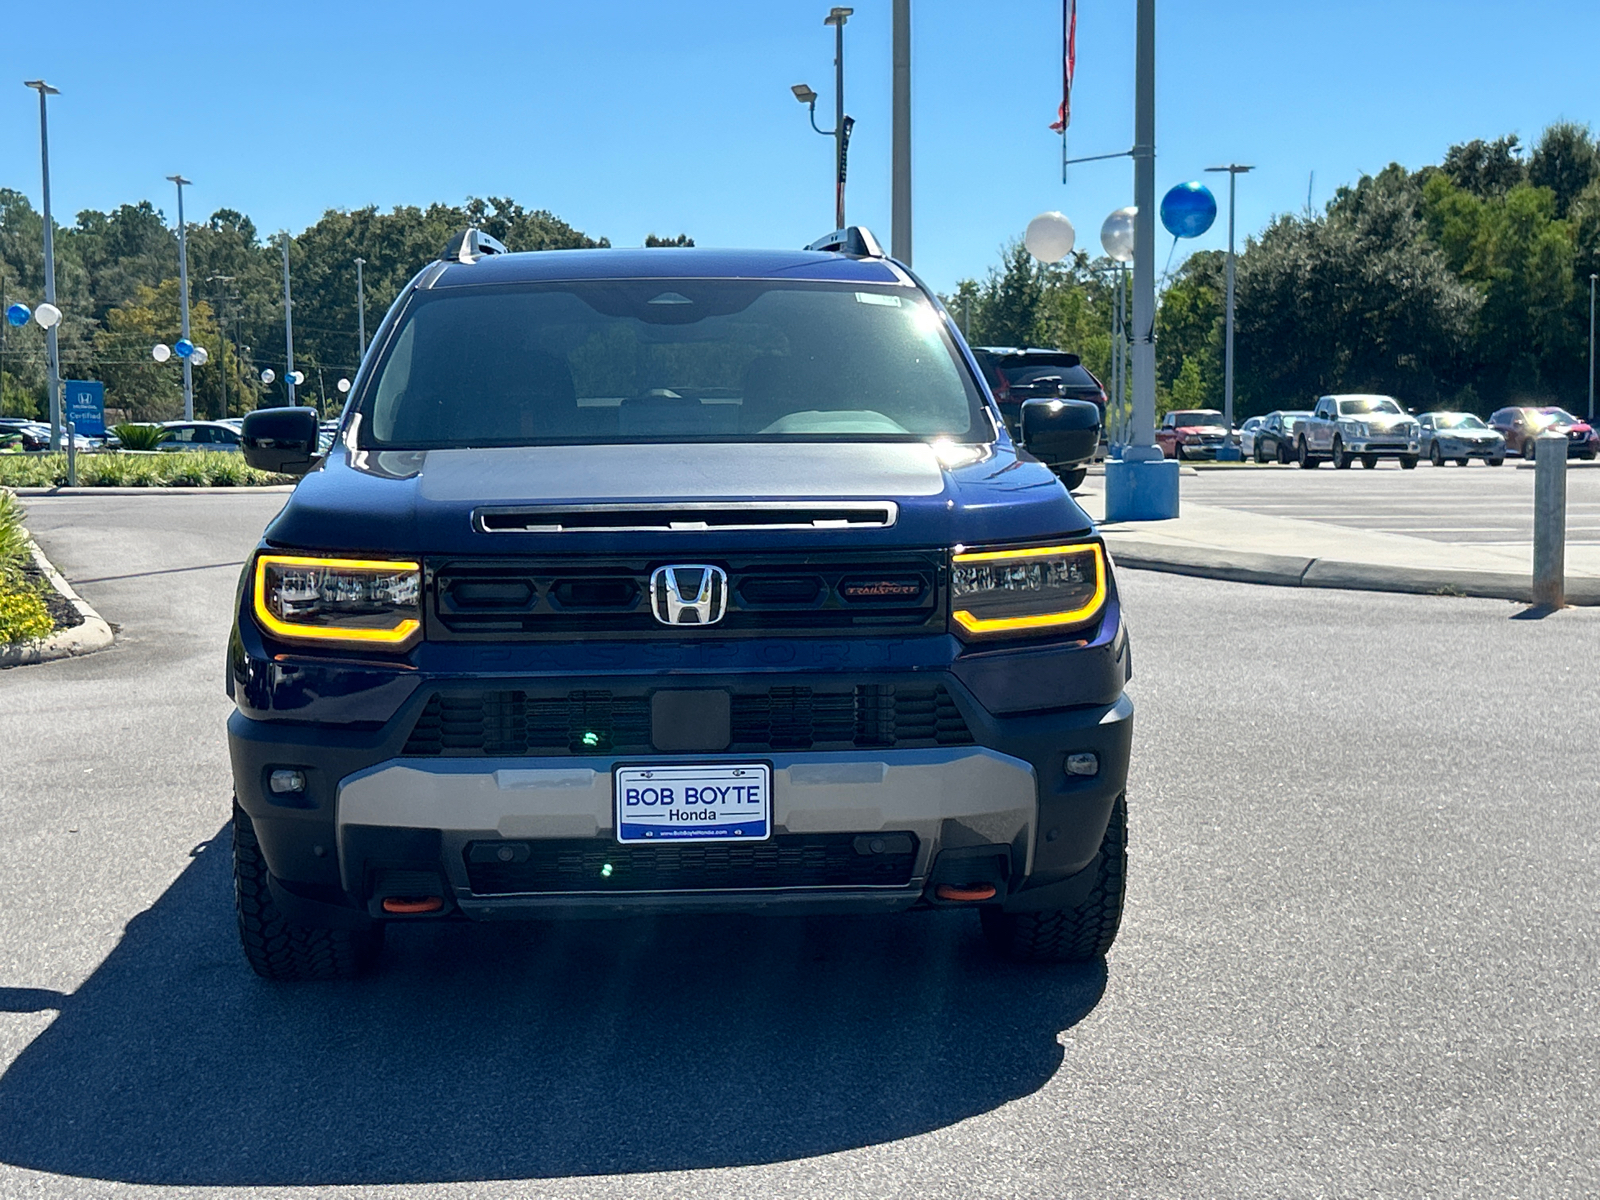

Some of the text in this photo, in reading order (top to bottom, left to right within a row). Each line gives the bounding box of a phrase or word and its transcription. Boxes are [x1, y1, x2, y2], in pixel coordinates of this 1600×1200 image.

[626, 786, 760, 806] BOB BOYTE
[669, 808, 717, 821] Honda
